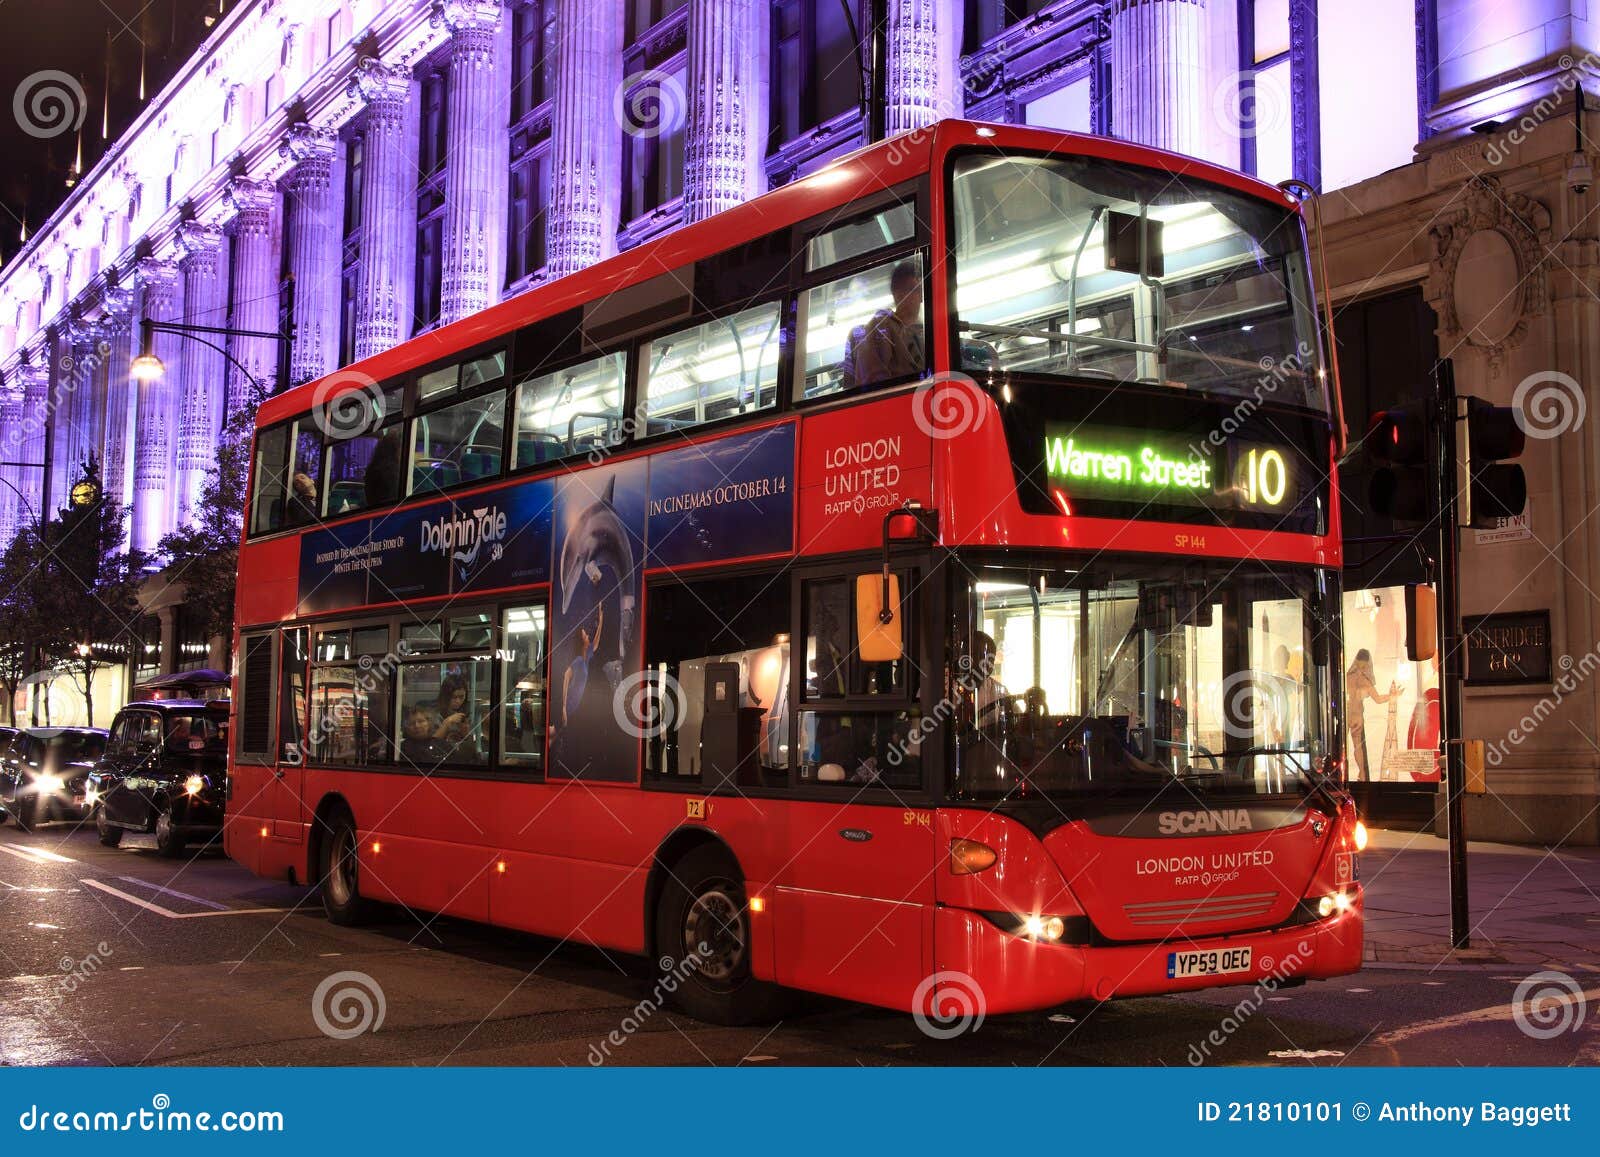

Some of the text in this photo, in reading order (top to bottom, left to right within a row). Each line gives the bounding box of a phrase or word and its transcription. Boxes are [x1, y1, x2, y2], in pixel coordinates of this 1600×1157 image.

[825, 435, 901, 470] LONDON
[1045, 436, 1211, 489] Warren Street
[824, 464, 901, 497] UNITED
[1248, 448, 1286, 505] 10
[648, 475, 786, 517] IN CINEMAS OCTOBER 14
[824, 492, 900, 516] RATP GROUP
[420, 507, 475, 557] Dolphin
[491, 543, 503, 561] 3D
[1470, 625, 1543, 649] SELFRIDGE
[1158, 808, 1252, 835] SCANIA
[1136, 850, 1274, 875] LONDON UNITED
[1175, 871, 1240, 886] RATP GROUP
[1179, 949, 1250, 974] YP59 OEC
